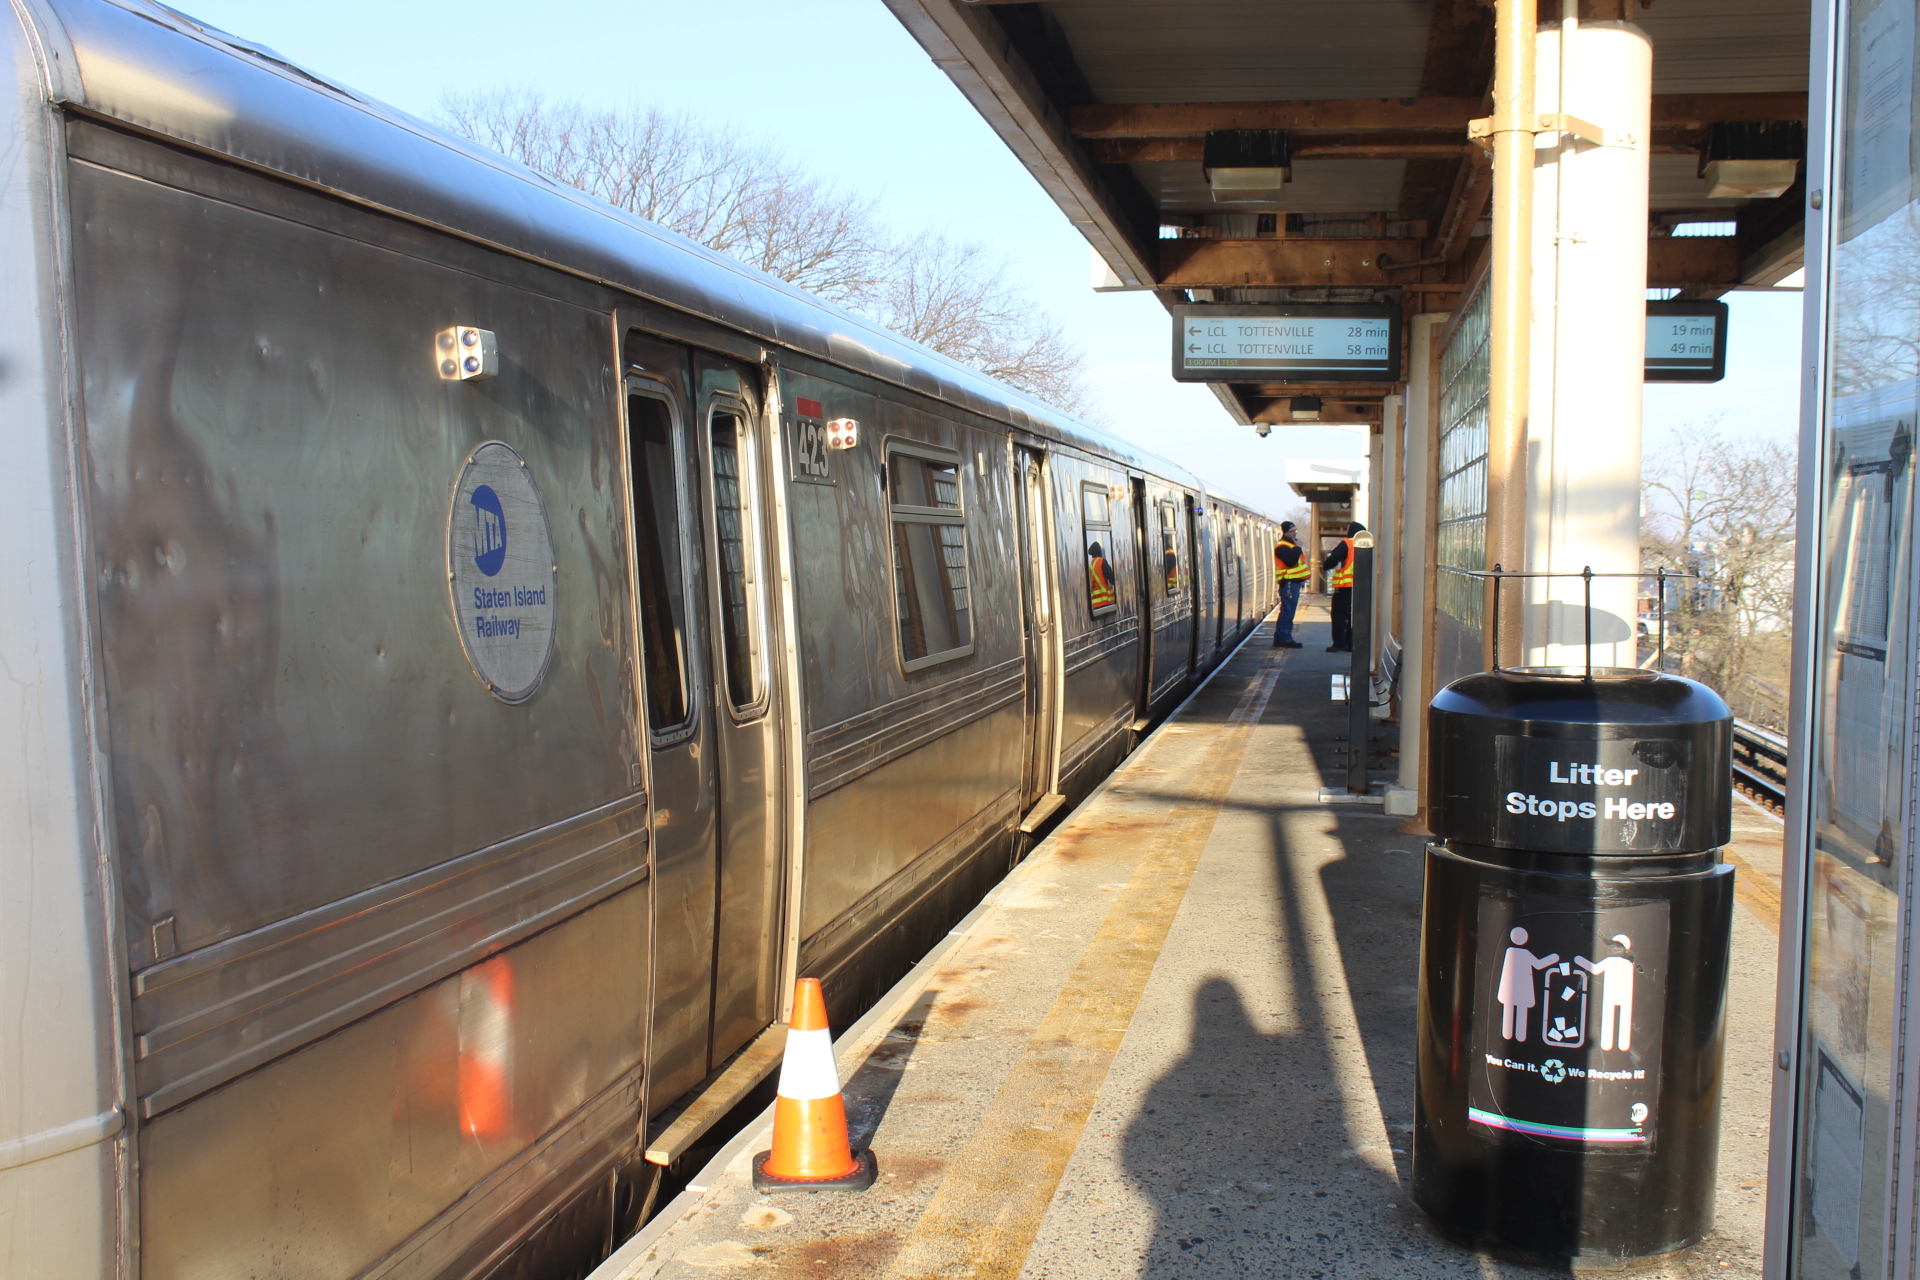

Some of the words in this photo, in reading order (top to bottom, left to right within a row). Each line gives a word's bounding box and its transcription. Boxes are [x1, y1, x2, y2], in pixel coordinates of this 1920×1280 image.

[1207, 326, 1227, 337] LCL
[1237, 326, 1314, 337] TOTTENVILLE
[1347, 326, 1362, 338] 28
[1365, 327, 1388, 338] min
[1671, 324, 1687, 336] 19
[1690, 324, 1714, 336] min
[1207, 343, 1227, 354] LCL
[1237, 343, 1314, 355] TOTTENVILLE
[1347, 344, 1362, 355] 58
[1365, 344, 1387, 355] min
[1670, 342, 1686, 354] 49
[1689, 342, 1713, 354] min
[798, 422, 829, 477] 423
[472, 505, 503, 558] MTA
[474, 586, 512, 610] Staten
[513, 584, 546, 607] Island
[476, 614, 521, 640] Railway
[1550, 761, 1639, 786] Litter
[1506, 791, 1597, 823] Stops
[1603, 796, 1676, 821] Here
[1484, 1053, 1503, 1066] You
[1504, 1058, 1525, 1070] Can
[1526, 1062, 1539, 1073] it.
[1567, 1067, 1586, 1078] We
[1587, 1068, 1633, 1082] Recycle
[1633, 1068, 1647, 1080] it!
